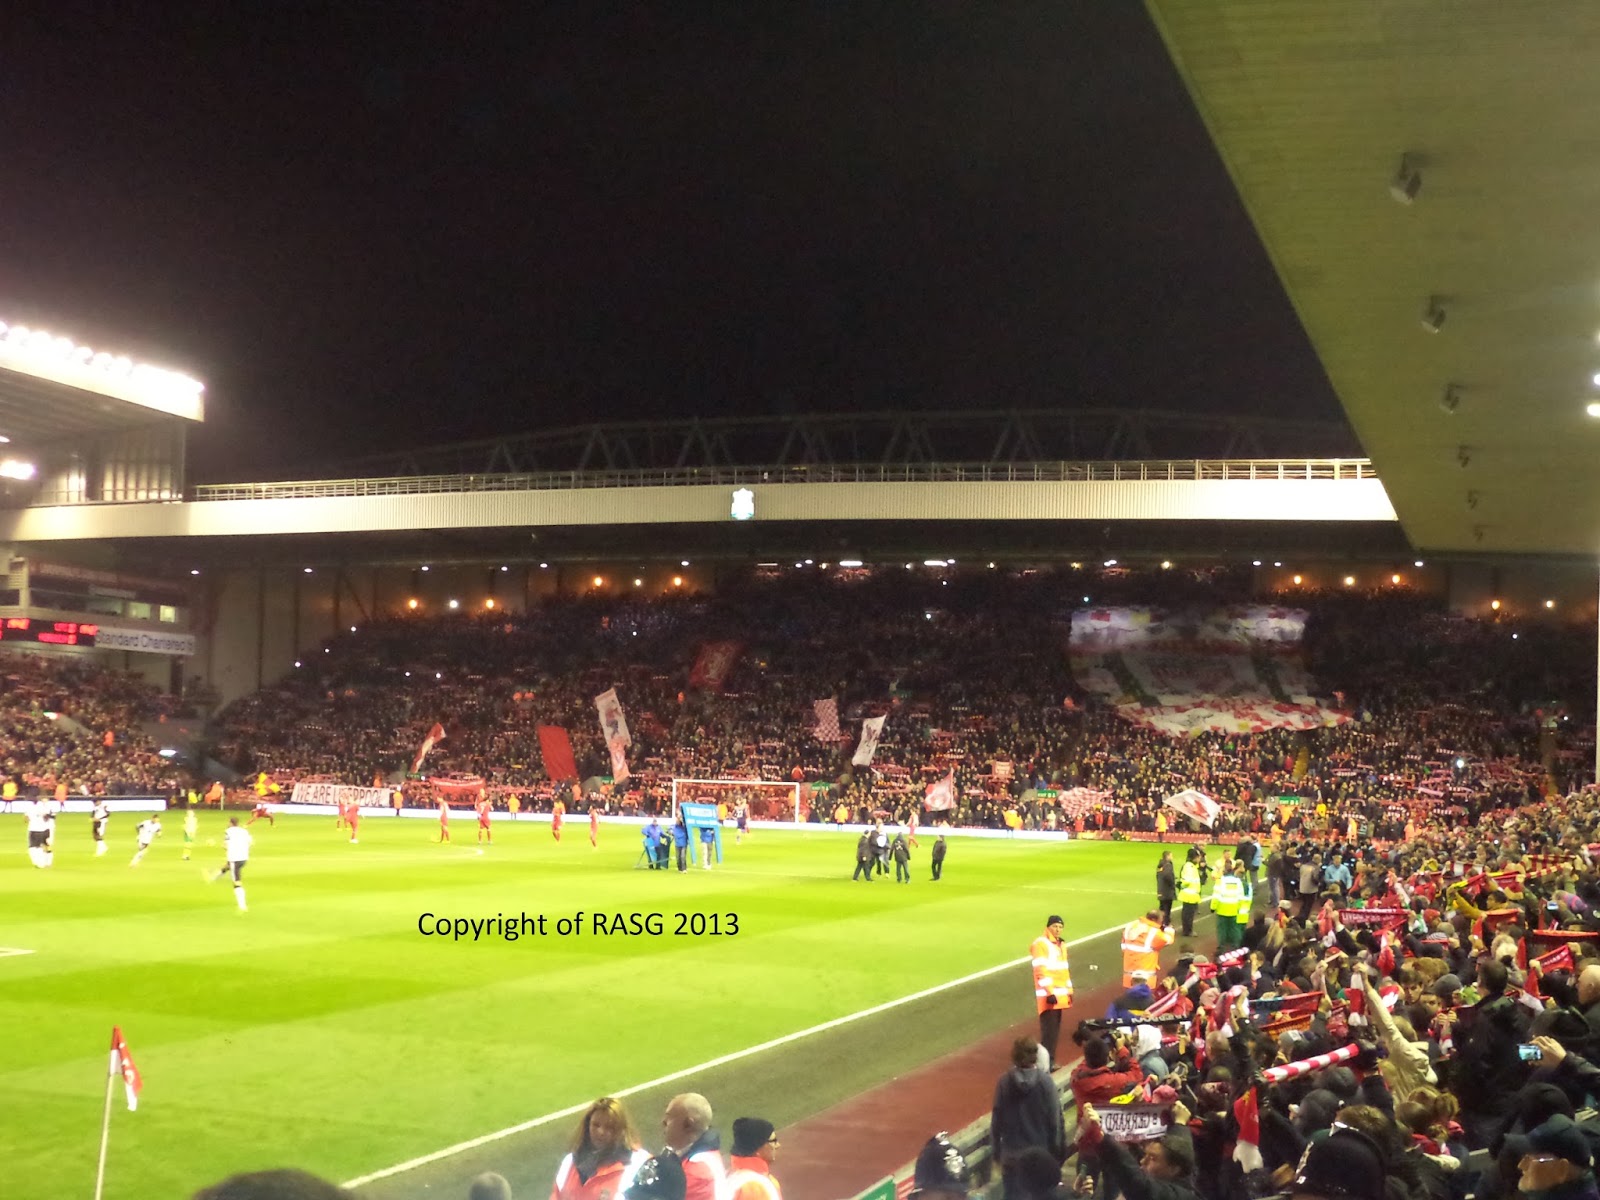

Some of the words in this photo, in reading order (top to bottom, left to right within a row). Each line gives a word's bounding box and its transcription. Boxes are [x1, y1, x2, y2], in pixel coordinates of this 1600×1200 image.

[95, 630, 139, 646] Standard
[141, 634, 185, 651] Chartered
[296, 784, 311, 803] WE
[313, 785, 331, 804] ARE
